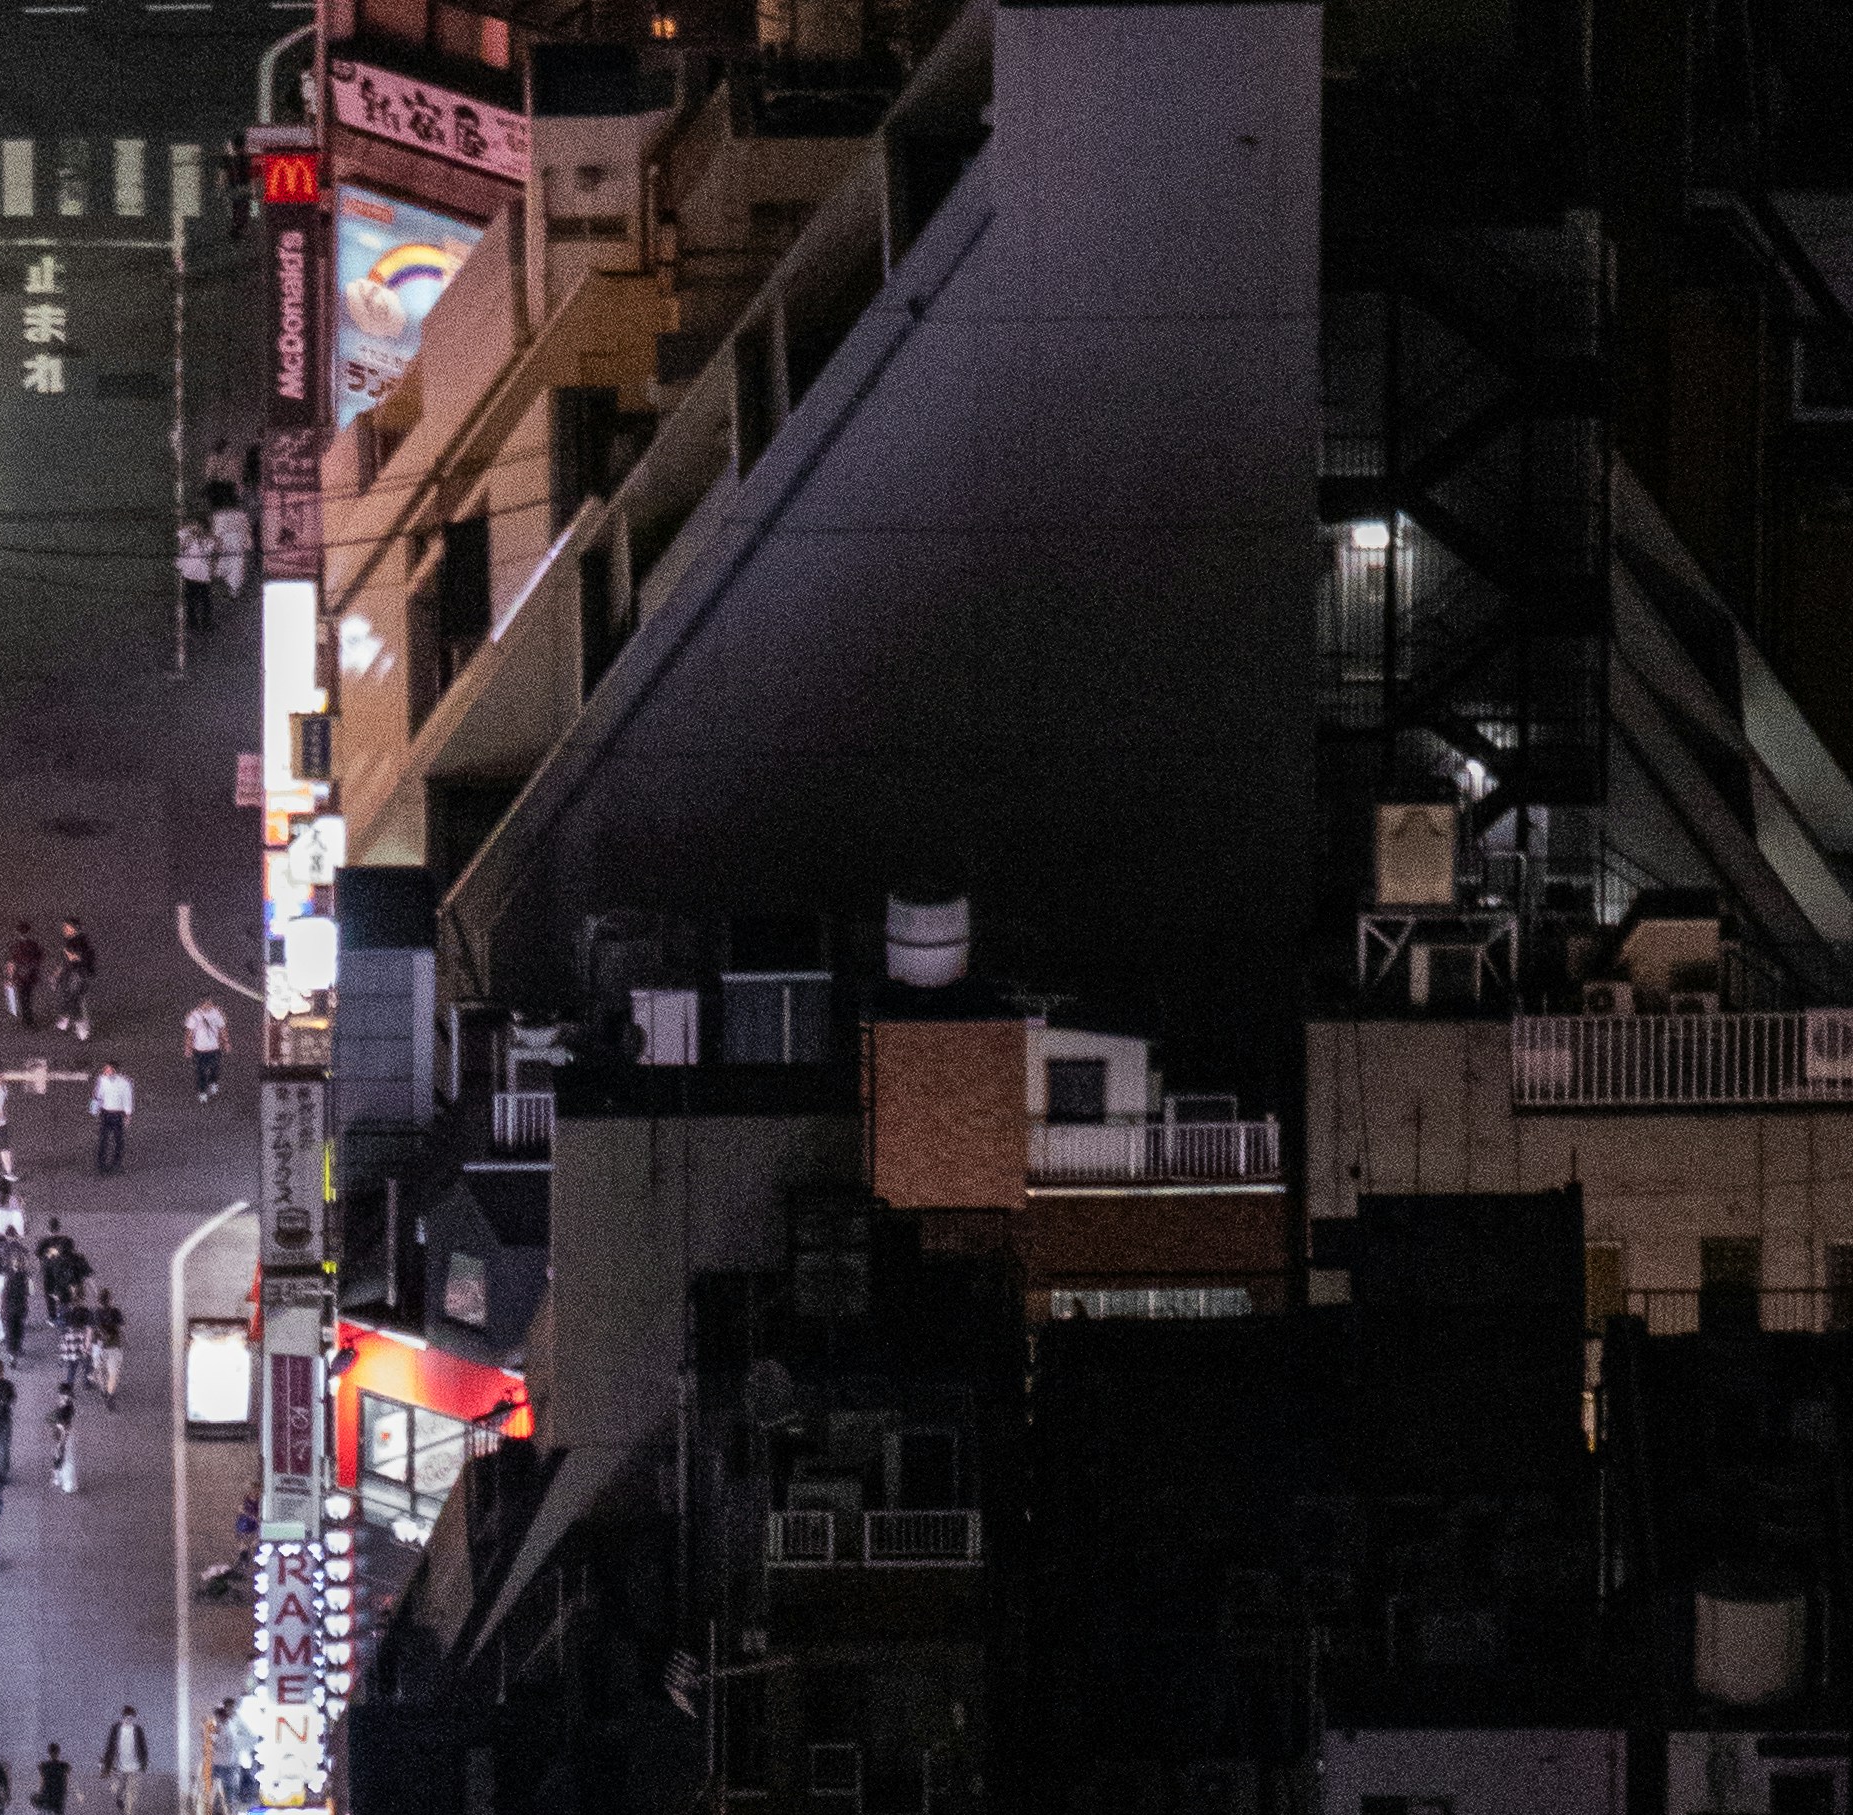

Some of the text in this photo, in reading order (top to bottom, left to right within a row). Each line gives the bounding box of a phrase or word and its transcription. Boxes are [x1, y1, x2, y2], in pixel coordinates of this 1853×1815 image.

[24, 256, 68, 394] 止まれ
[277, 231, 306, 401] McDonald's
[273, 1552, 312, 1744] RAMEN
